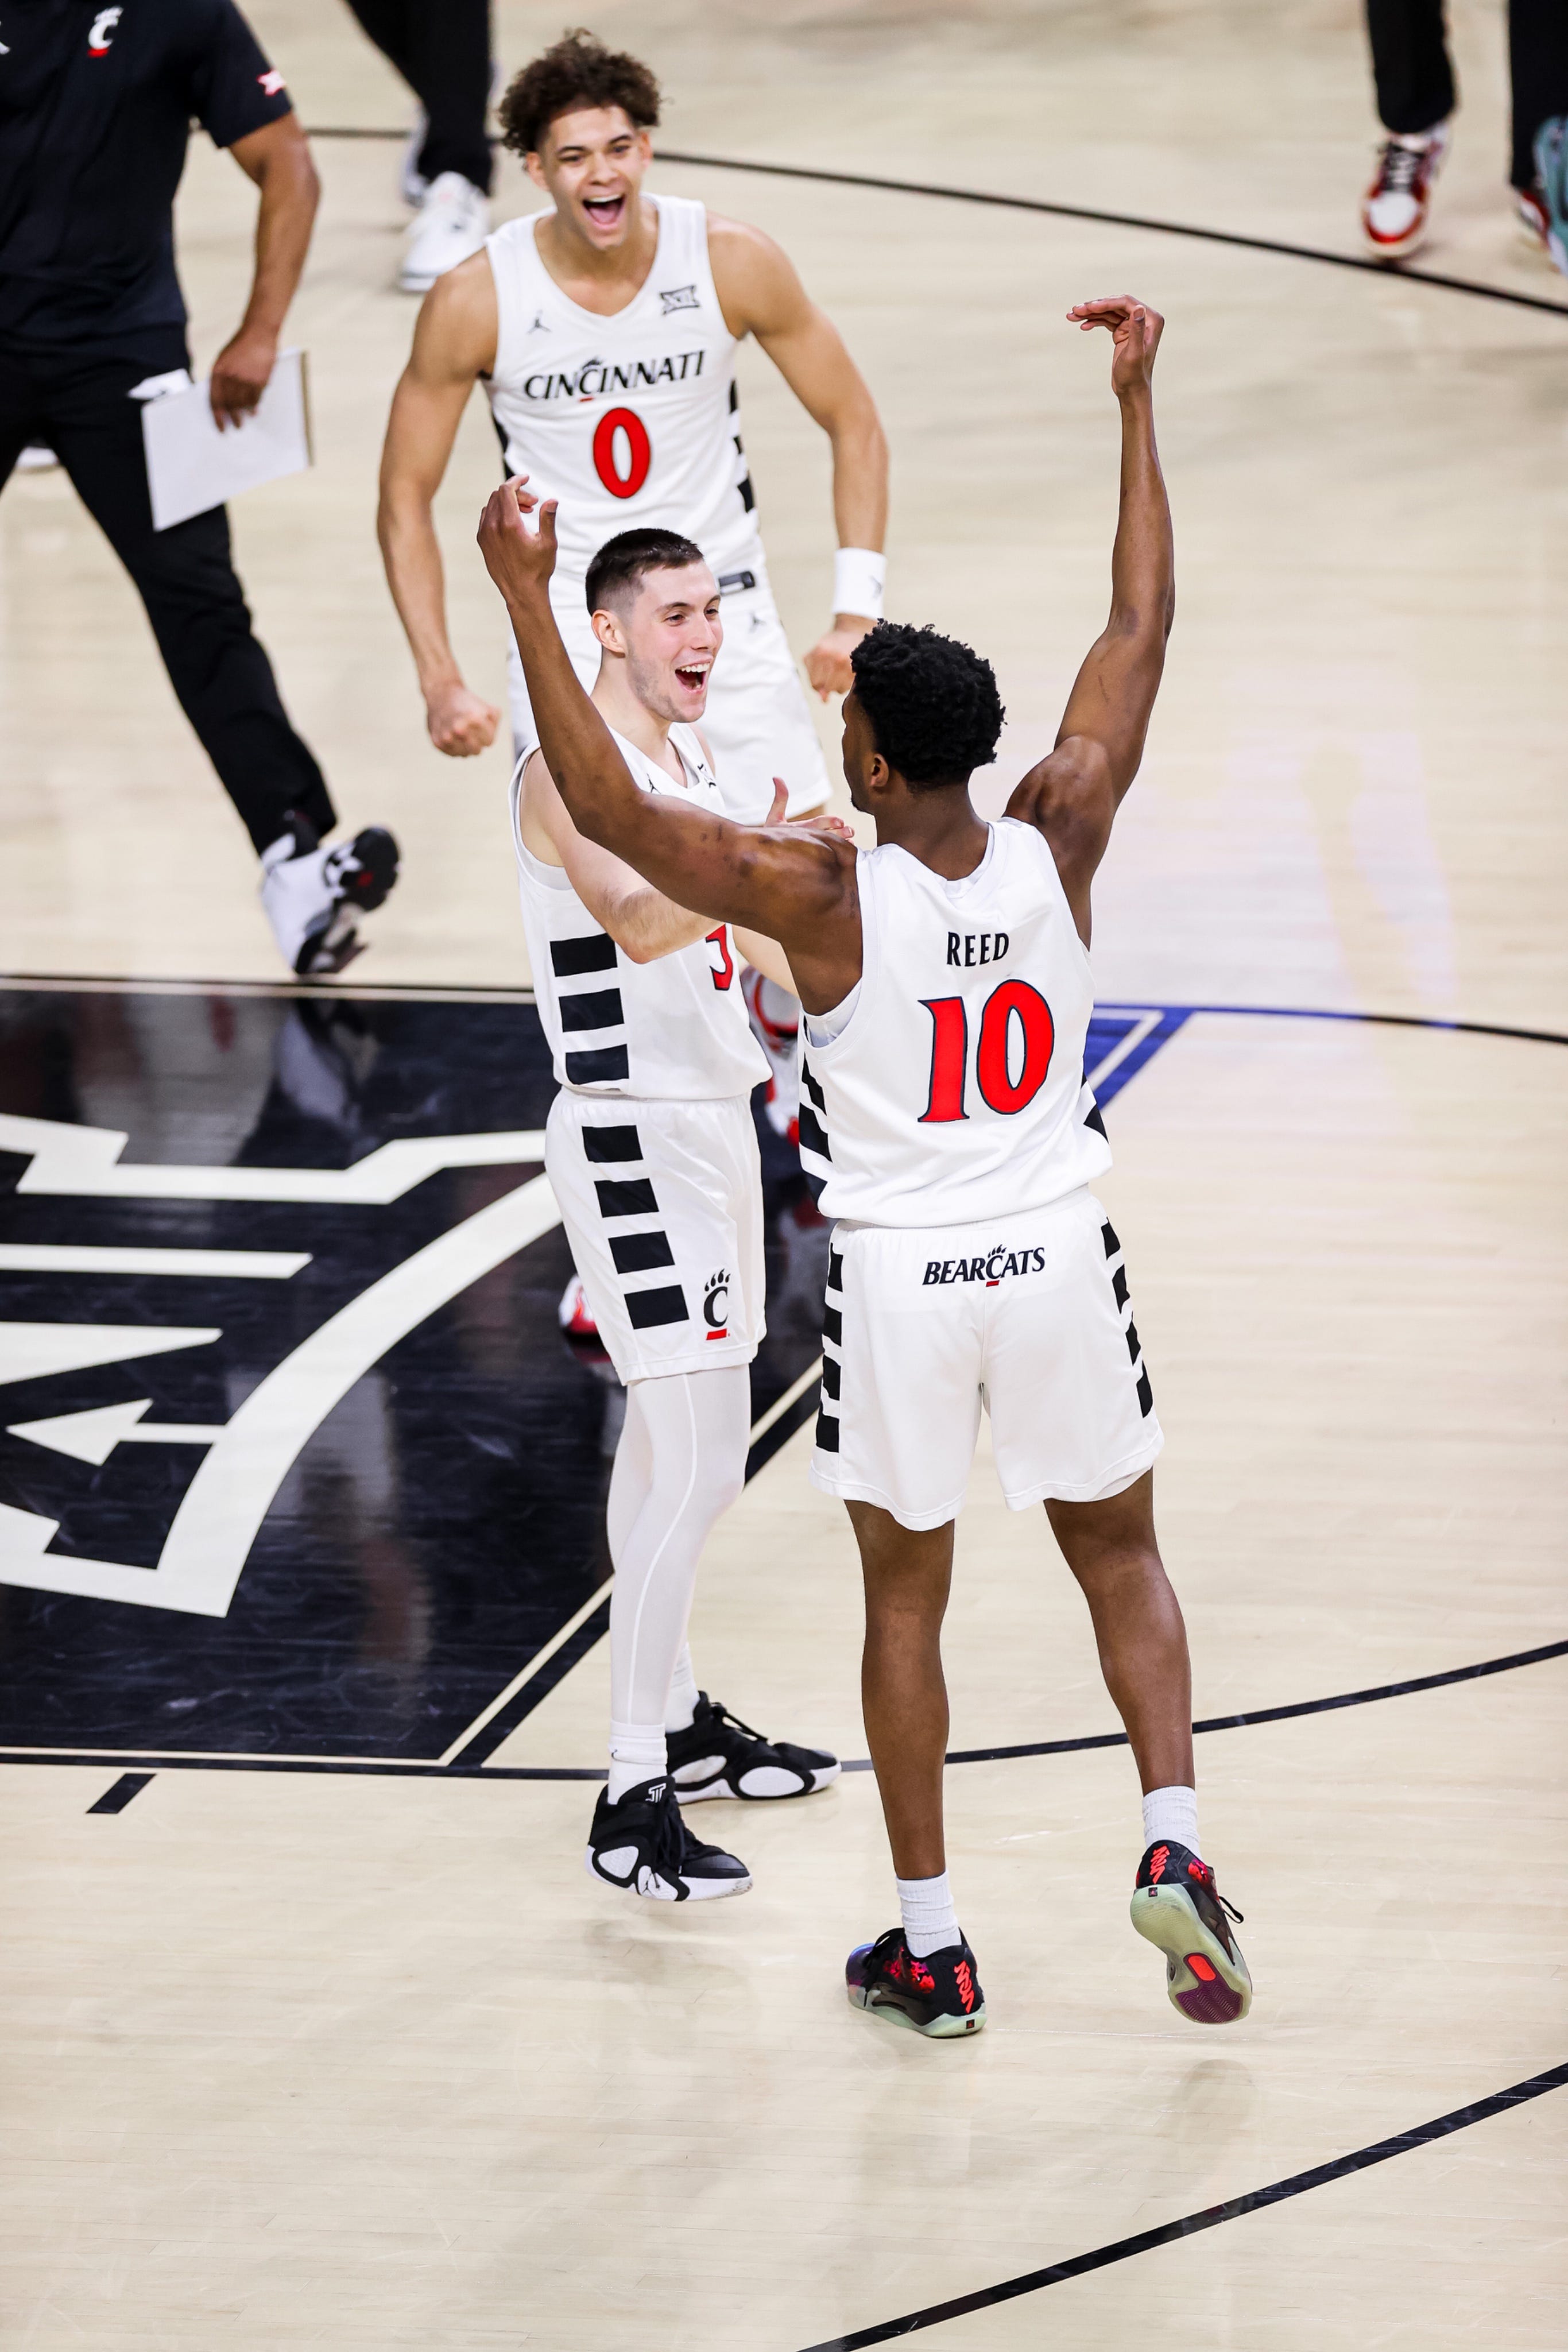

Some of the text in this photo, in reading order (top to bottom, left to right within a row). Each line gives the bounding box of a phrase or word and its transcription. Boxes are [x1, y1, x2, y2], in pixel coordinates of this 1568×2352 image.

[524, 350, 705, 399] CINCINNATI
[592, 407, 652, 499] 0
[946, 931, 1010, 967] REED
[917, 978, 1055, 1123] 10
[922, 1244, 1045, 1285] BEARCATS
